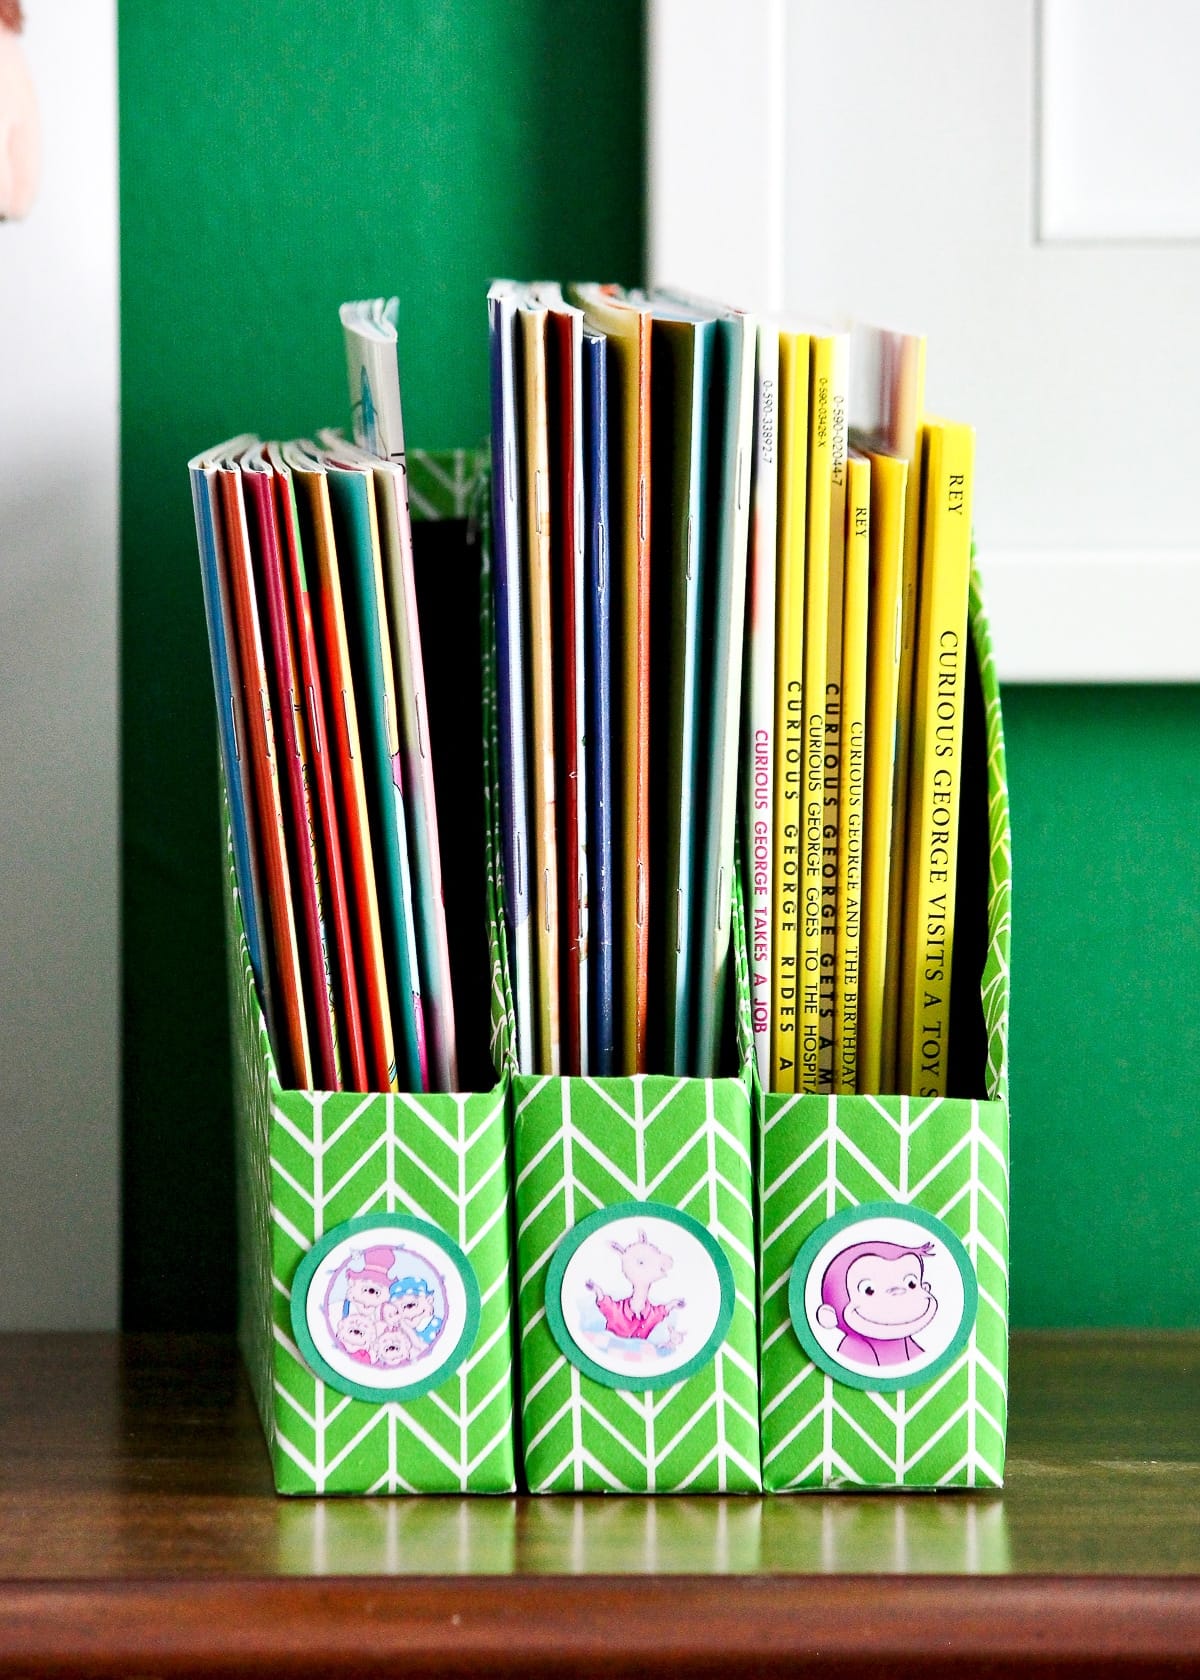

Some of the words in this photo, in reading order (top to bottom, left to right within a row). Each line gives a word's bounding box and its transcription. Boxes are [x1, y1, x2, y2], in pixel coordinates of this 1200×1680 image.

[832, 395, 844, 486] 0-590-02044-7
[855, 507, 867, 538] REY
[948, 474, 964, 516] REY
[935, 630, 958, 758] CURIOUS
[755, 729, 768, 810] CURIOUS
[785, 681, 802, 800] CURIOUS
[808, 714, 823, 792] CURIOUS
[824, 683, 839, 807] CURIOUS
[849, 721, 862, 806] CURIOUS
[754, 821, 768, 896] GEORGE
[807, 802, 821, 877] GEORGE
[847, 814, 860, 891] GEORGE
[930, 769, 952, 884] GEORGE
[782, 824, 798, 931] GEORGE
[805, 887, 819, 937] GOES
[821, 824, 836, 936] GEORGE
[754, 906, 768, 962] TAKES
[846, 898, 858, 938] AND
[925, 893, 947, 981] VISITS
[754, 973, 767, 987] A
[781, 956, 795, 1033] RIDES
[805, 948, 818, 972] TO
[819, 953, 834, 1018] GETS
[844, 946, 858, 985] THE
[754, 998, 767, 1034] JOB
[804, 982, 818, 1014] THE
[923, 993, 942, 1009] A
[779, 1057, 793, 1071] A
[819, 1036, 833, 1050] A
[842, 993, 856, 1088] BIRTHDAY
[921, 1021, 941, 1078] TOY
